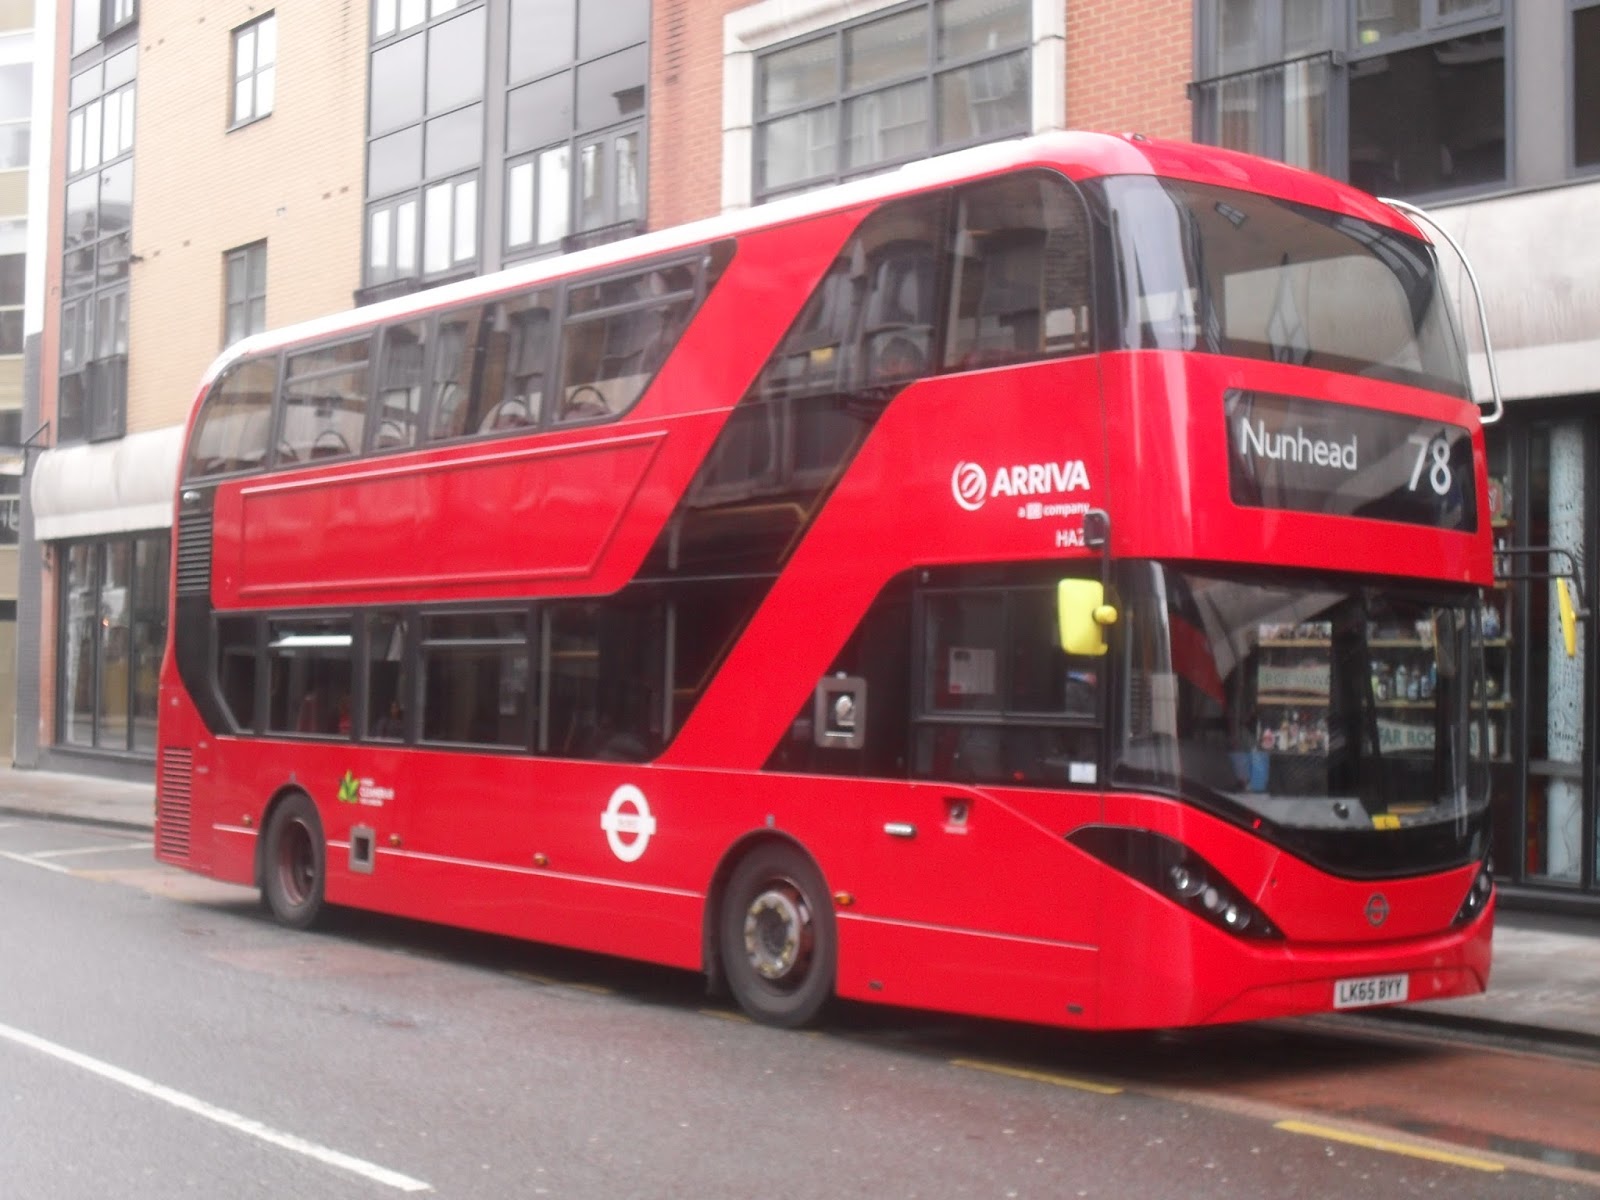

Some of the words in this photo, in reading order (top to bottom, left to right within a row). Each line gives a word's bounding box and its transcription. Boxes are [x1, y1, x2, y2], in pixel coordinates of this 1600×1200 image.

[1240, 416, 1358, 471] Nunhead
[1408, 434, 1452, 496] 78
[990, 459, 1091, 498] ARRIVA
[1043, 502, 1090, 518] company
[1055, 528, 1085, 548] HA2
[1340, 981, 1376, 1004] LK65
[1378, 978, 1402, 1000] BYY
